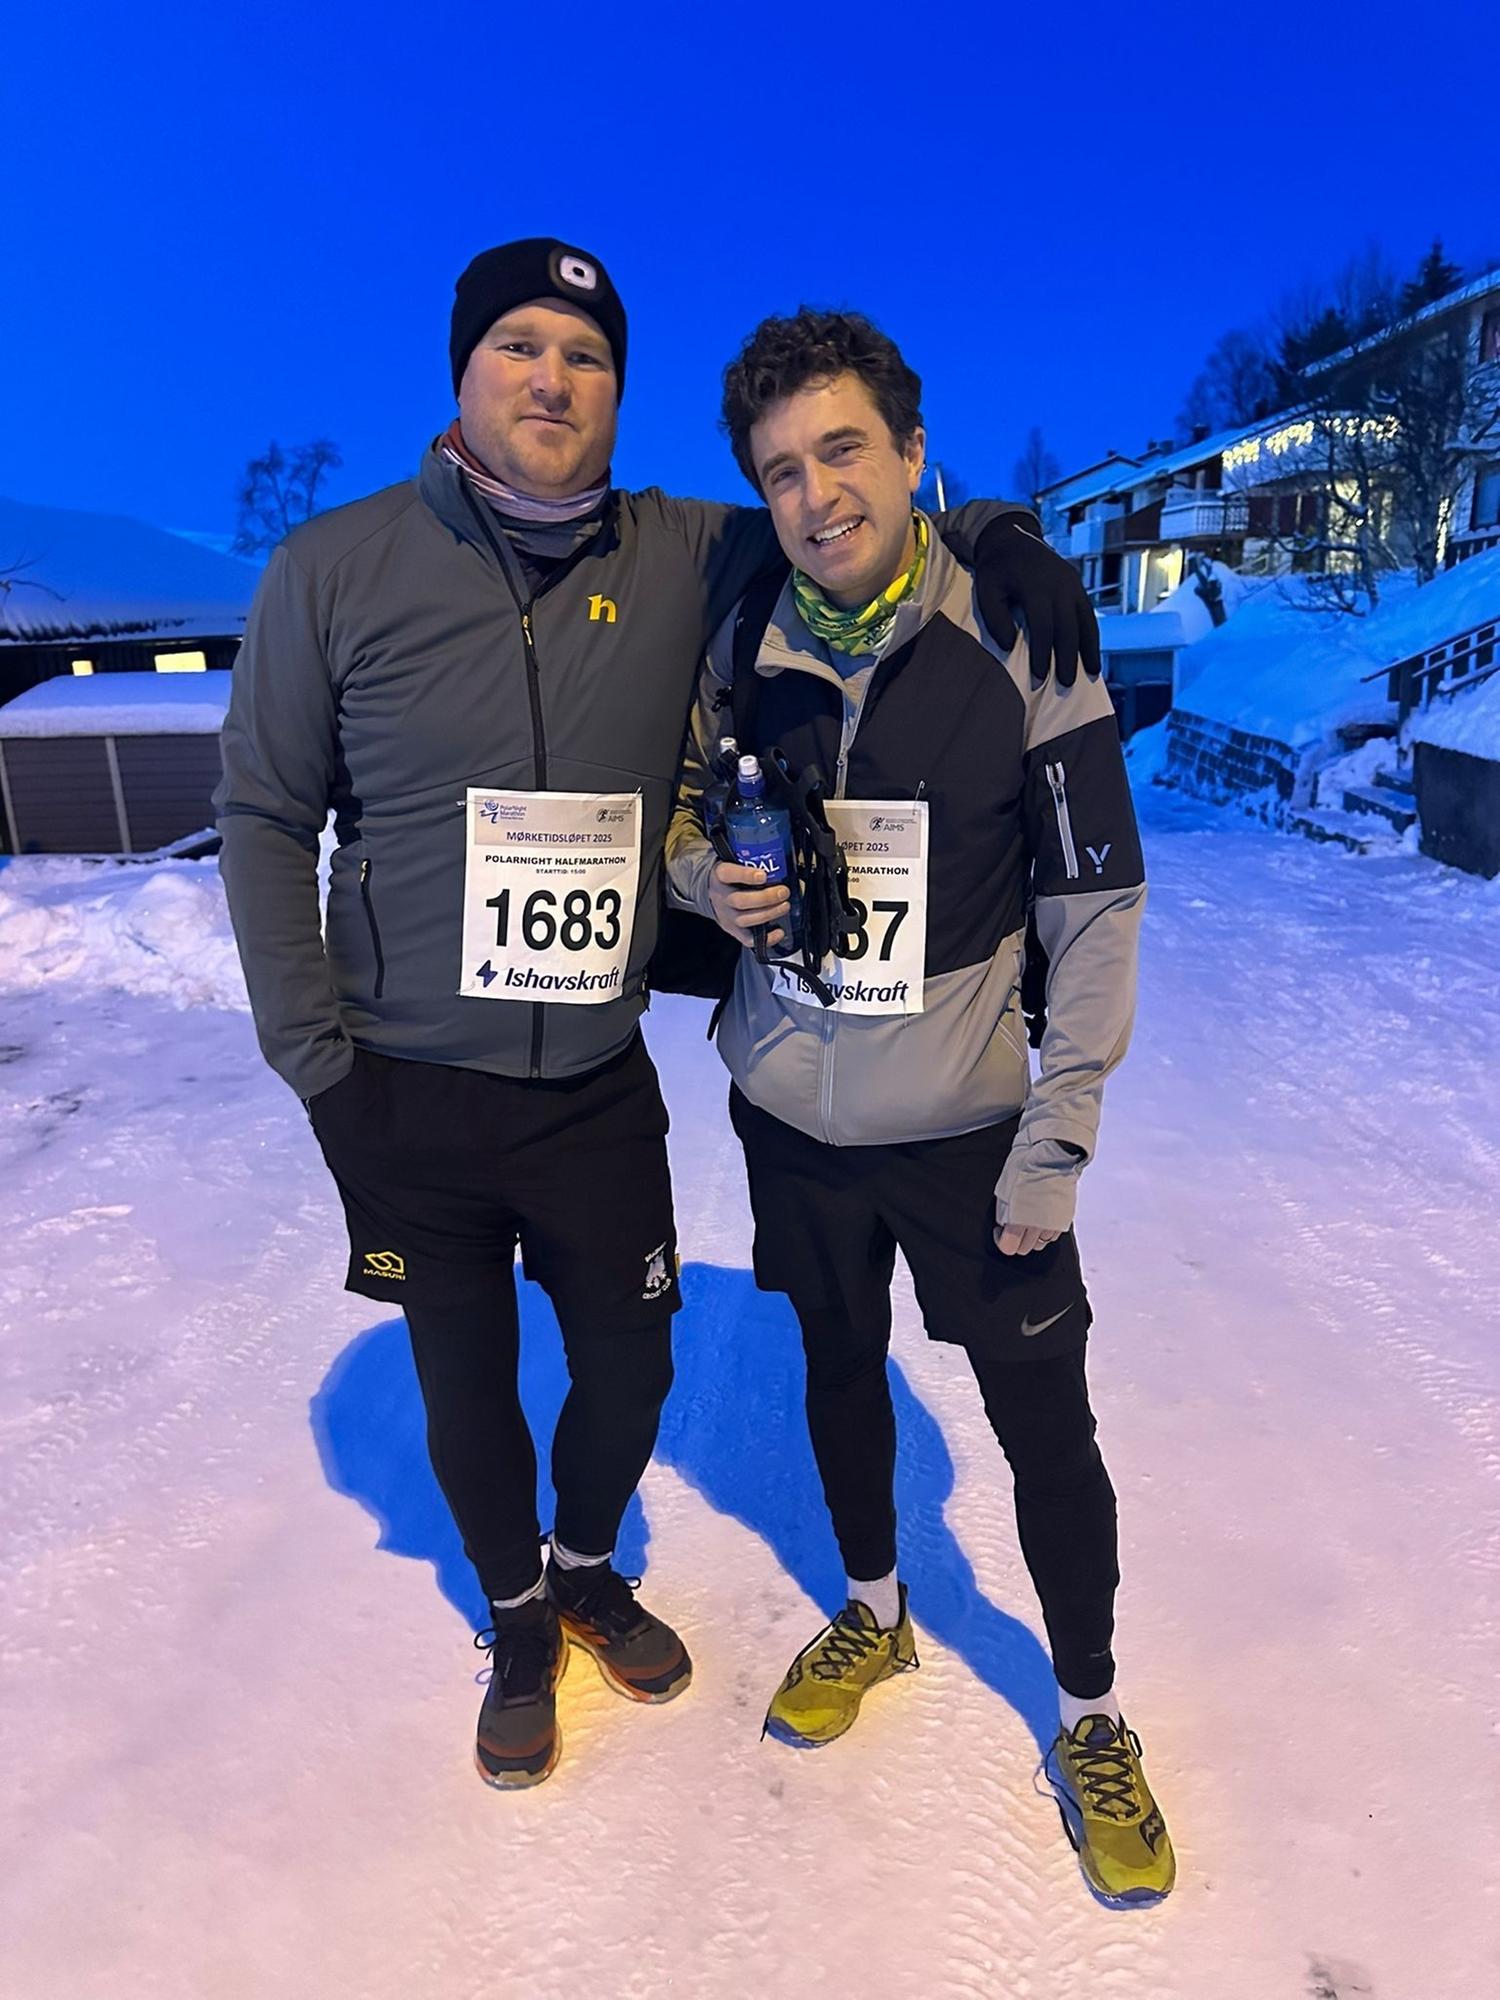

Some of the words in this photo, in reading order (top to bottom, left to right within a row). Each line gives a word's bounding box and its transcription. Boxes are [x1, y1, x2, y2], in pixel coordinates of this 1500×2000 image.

[883, 823, 905, 832] AIMS
[506, 831, 591, 844] MØRKETIDSLØPET
[592, 833, 613, 843] 2025
[866, 842, 890, 852] 2025
[485, 854, 553, 865] POLARNIGHT
[555, 856, 627, 866] HALFMARATHON
[738, 858, 780, 873] DAL
[486, 888, 622, 951] 1683
[504, 965, 620, 991] Ishavskraft
[796, 974, 909, 1002] Isvskraft
